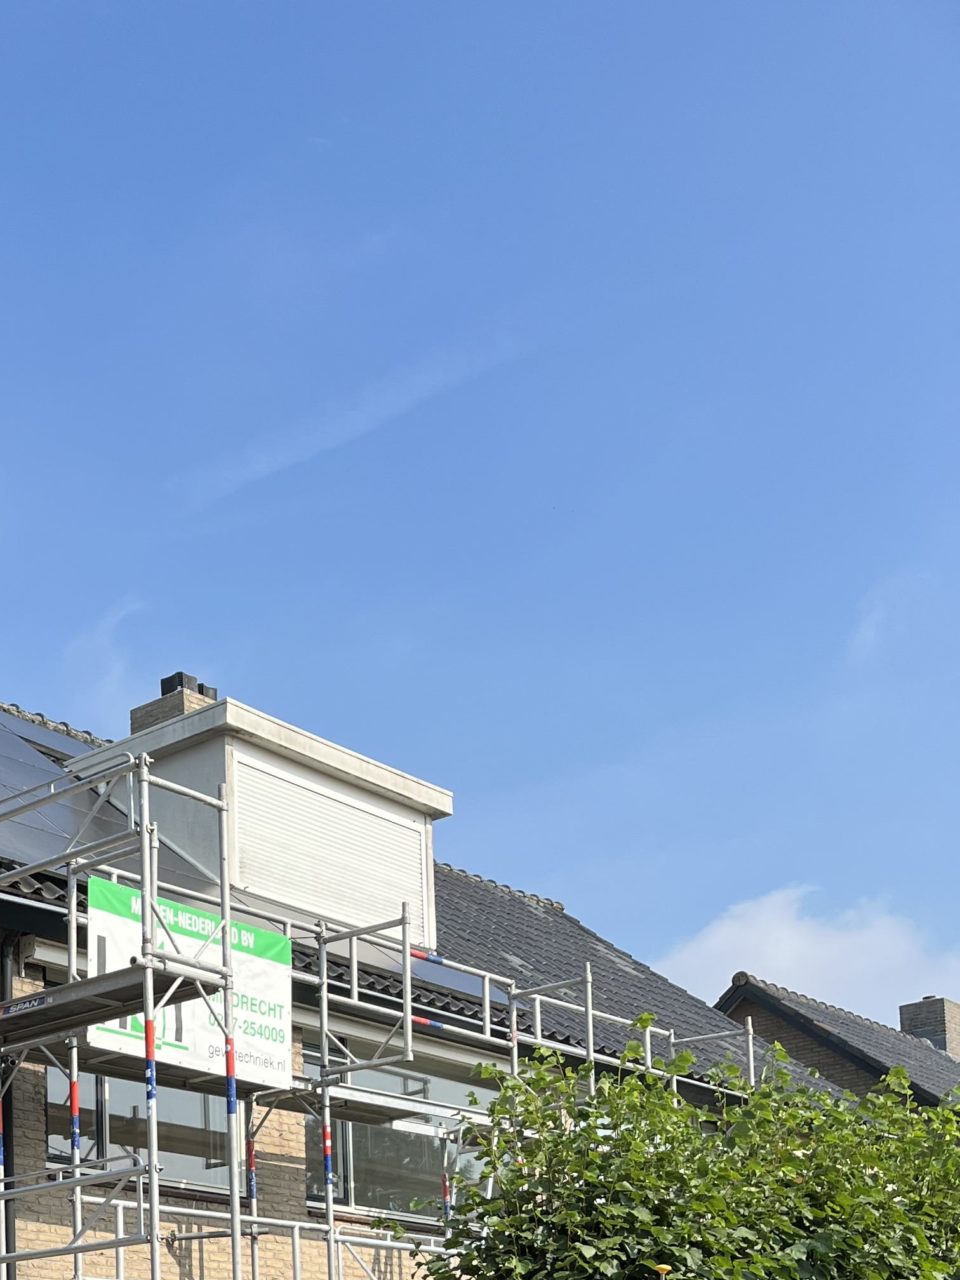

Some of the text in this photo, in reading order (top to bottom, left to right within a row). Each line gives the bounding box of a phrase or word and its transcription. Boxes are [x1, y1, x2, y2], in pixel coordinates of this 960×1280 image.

[241, 929, 255, 948] BV
[8, 999, 40, 1013] SPAN
[208, 1013, 286, 1044] 027-254009
[208, 1044, 286, 1072] gevtechniek.nl
